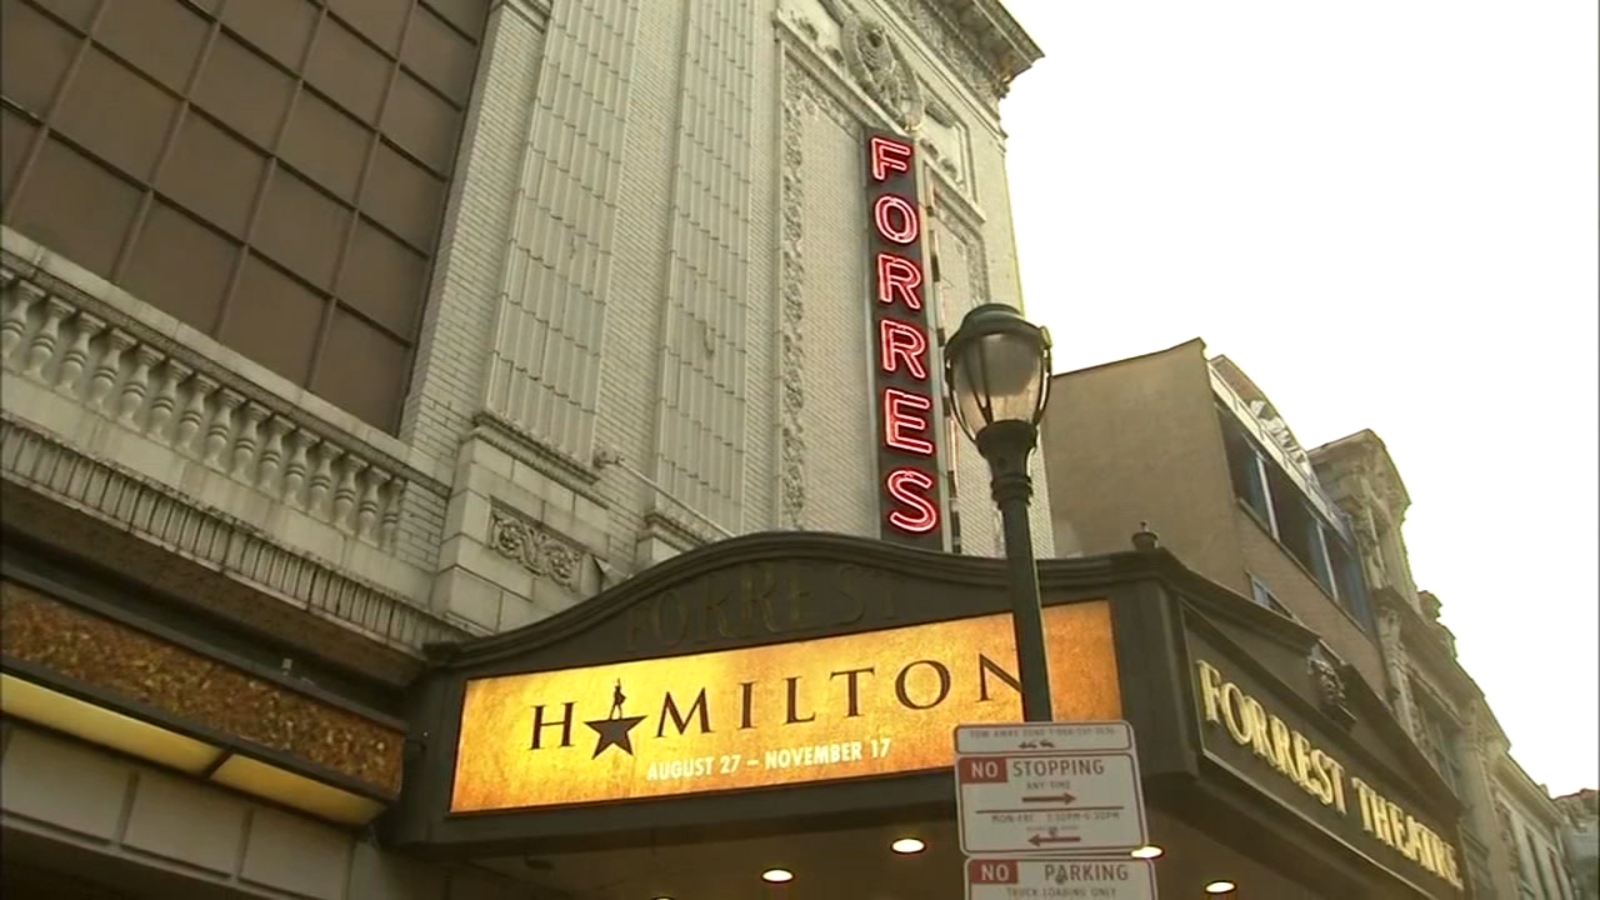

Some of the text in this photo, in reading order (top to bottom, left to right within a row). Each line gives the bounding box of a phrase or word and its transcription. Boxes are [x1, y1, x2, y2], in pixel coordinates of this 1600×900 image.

[647, 757, 713, 781] AUGUST
[720, 755, 741, 774] 27
[765, 741, 862, 770] NOVEMBER
[870, 739, 891, 758] 17
[971, 759, 1105, 778] NO STOPPING
[1197, 660, 1464, 890] FORREST THEATRE
[981, 864, 1129, 881] NO PARKING
